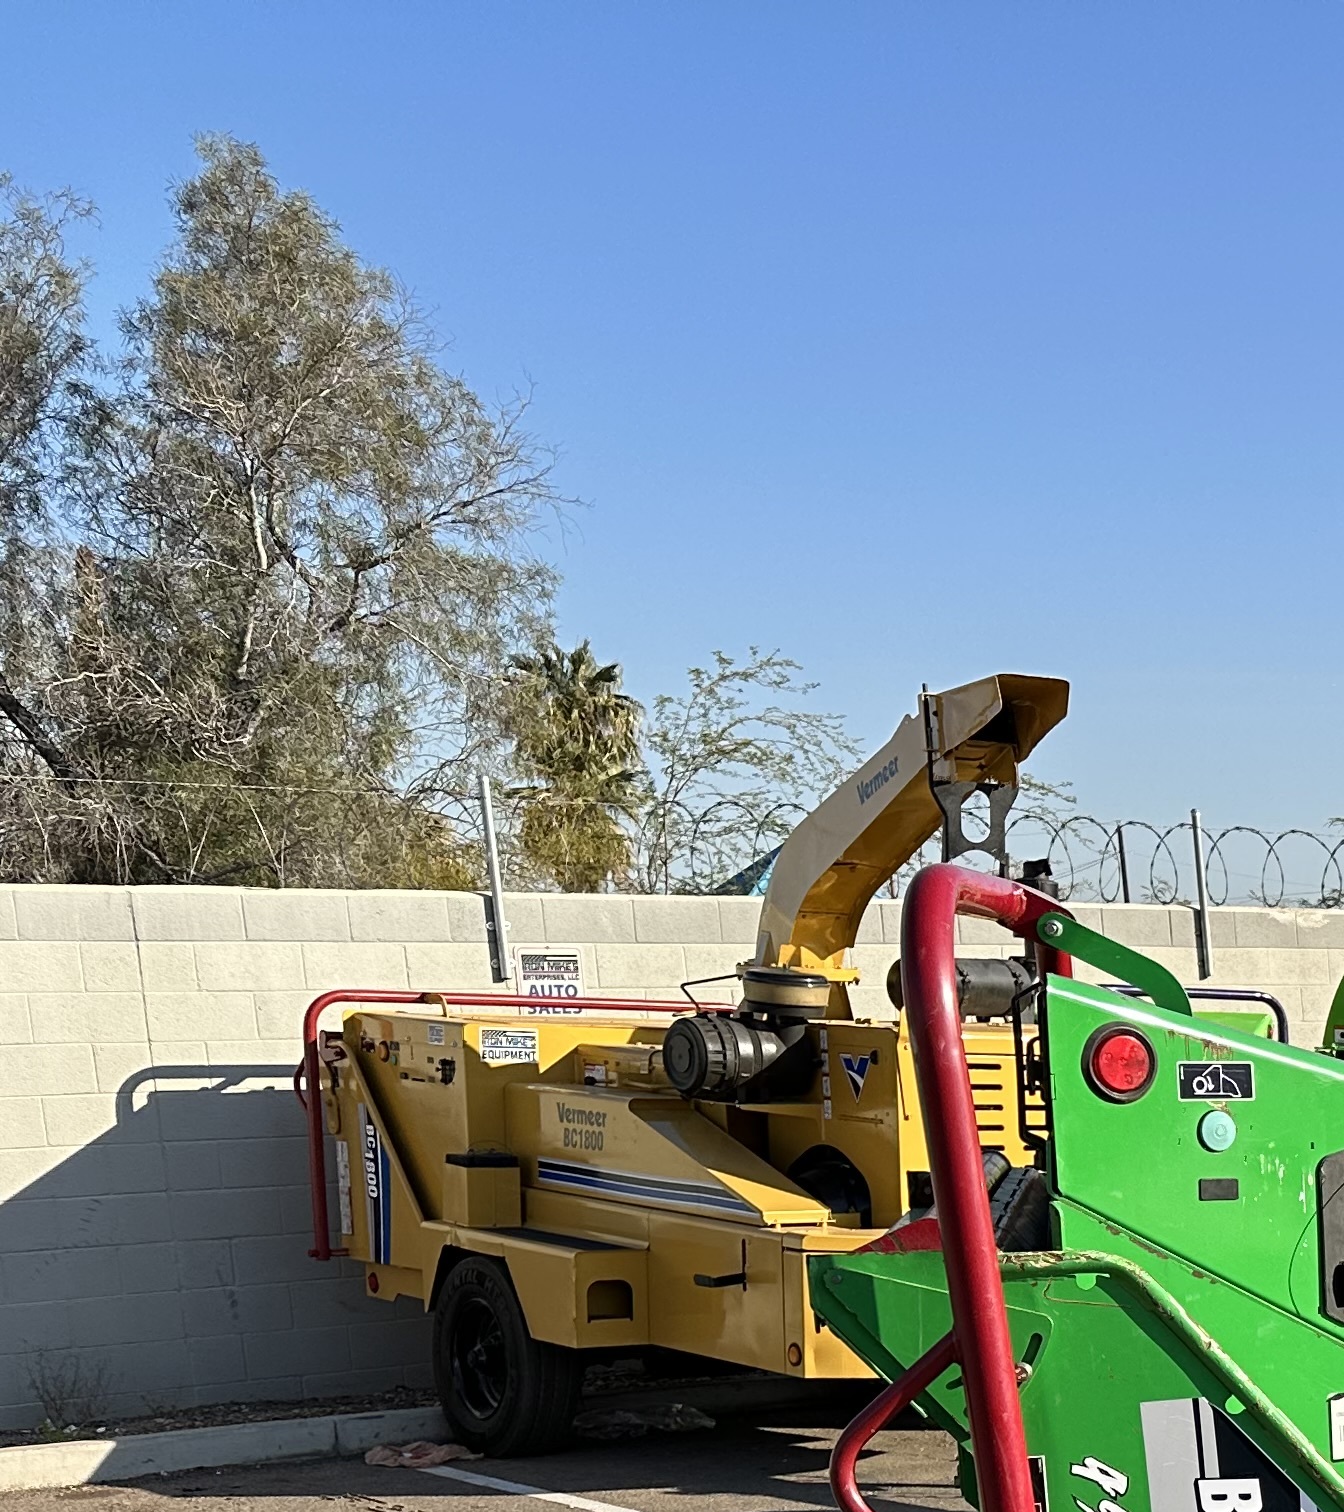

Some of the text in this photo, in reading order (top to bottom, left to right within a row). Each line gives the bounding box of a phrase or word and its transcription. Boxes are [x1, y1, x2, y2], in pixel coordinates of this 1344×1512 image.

[856, 755, 899, 806] Vermeer
[528, 984, 578, 998] AUTO
[481, 1049, 537, 1060] EQUIPMENT
[556, 1101, 607, 1128] Vermeer
[563, 1127, 604, 1151] BC1800
